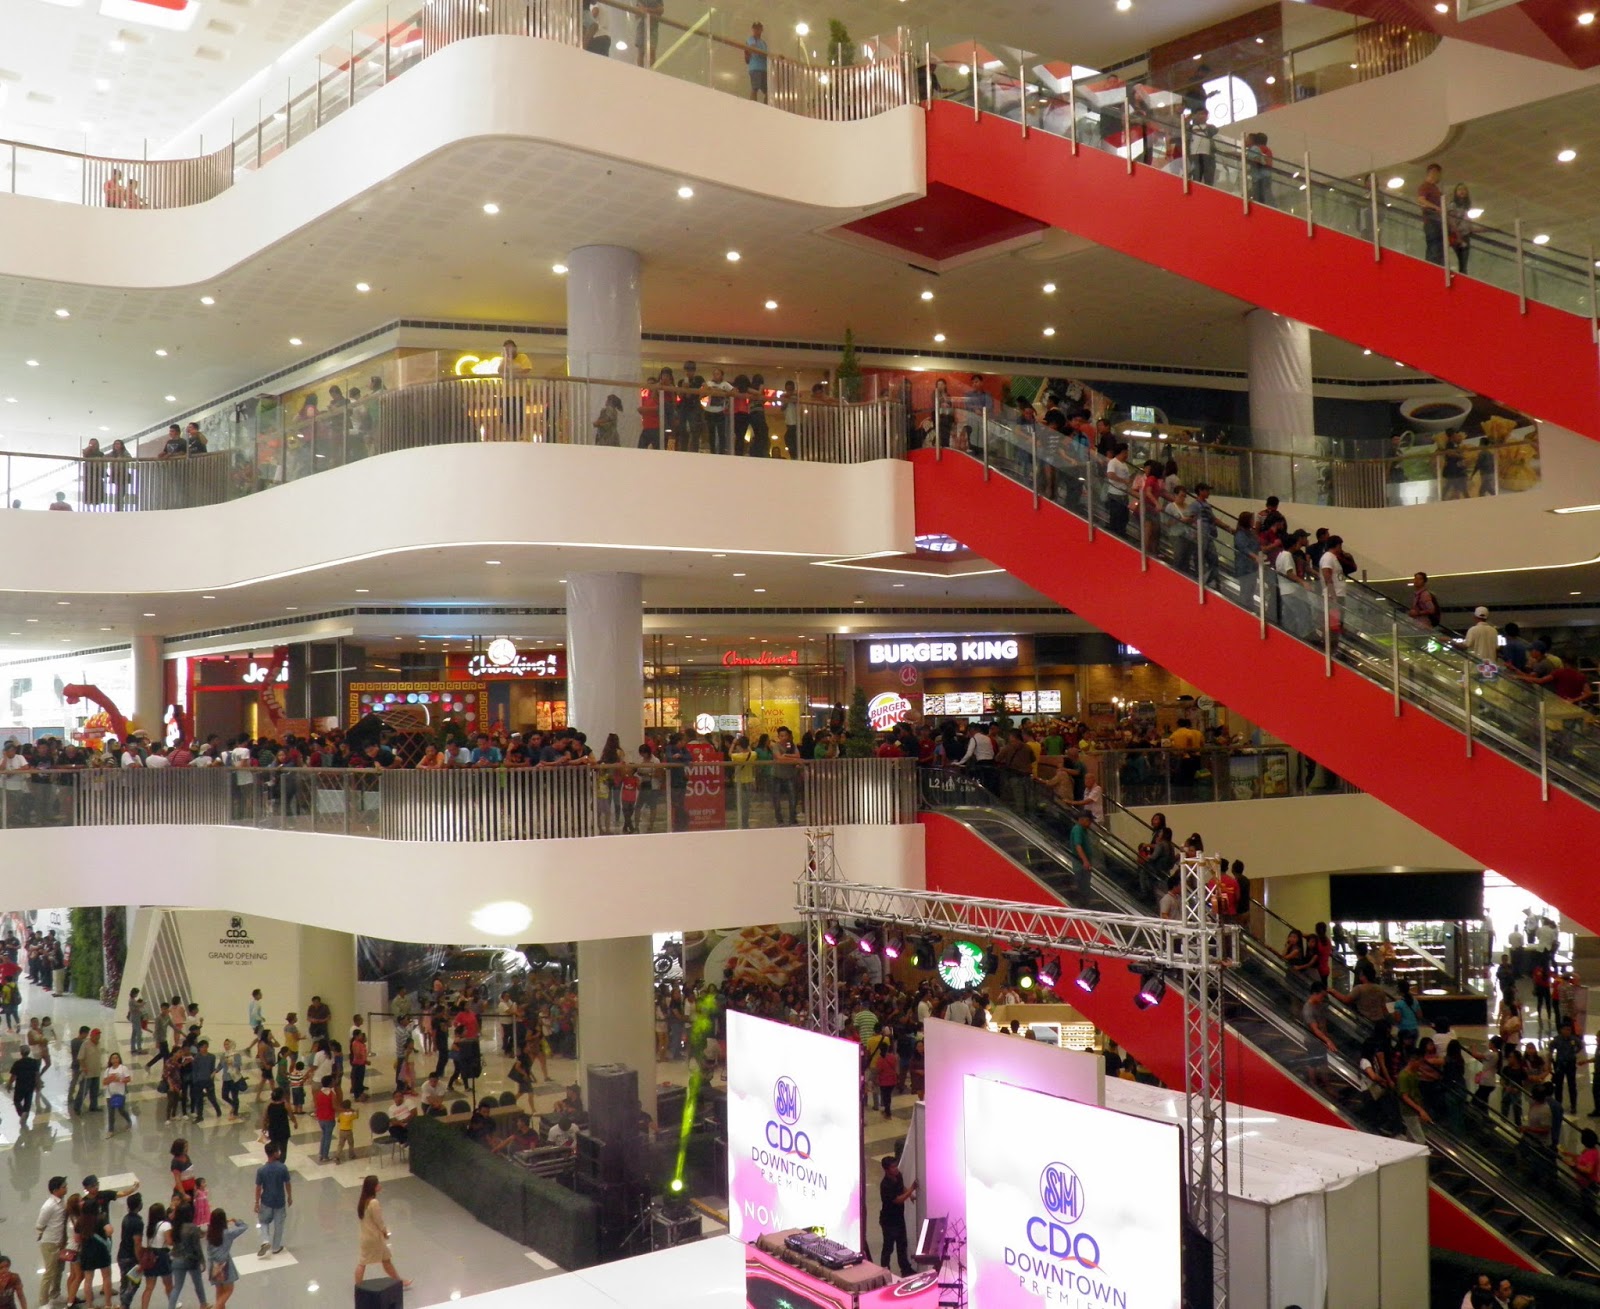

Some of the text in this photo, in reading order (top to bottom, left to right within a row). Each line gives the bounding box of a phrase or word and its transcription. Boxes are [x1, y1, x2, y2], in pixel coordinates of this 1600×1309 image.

[722, 650, 788, 668] Chowking
[869, 640, 1018, 664] BURGER KING
[764, 708, 785, 716] WOK
[870, 701, 907, 719] BURGER
[226, 929, 248, 938] CDO
[208, 951, 268, 961] GRAND OPENING
[776, 1080, 798, 1120] SM
[765, 1120, 811, 1160] CDO
[752, 1146, 828, 1191] DOWNTOWN
[761, 1168, 816, 1199] PREMIER
[1044, 1166, 1077, 1219] SM
[744, 1199, 784, 1231] NOW
[1026, 1216, 1100, 1269] CDO
[1004, 1246, 1126, 1309] DOWNTOWN
